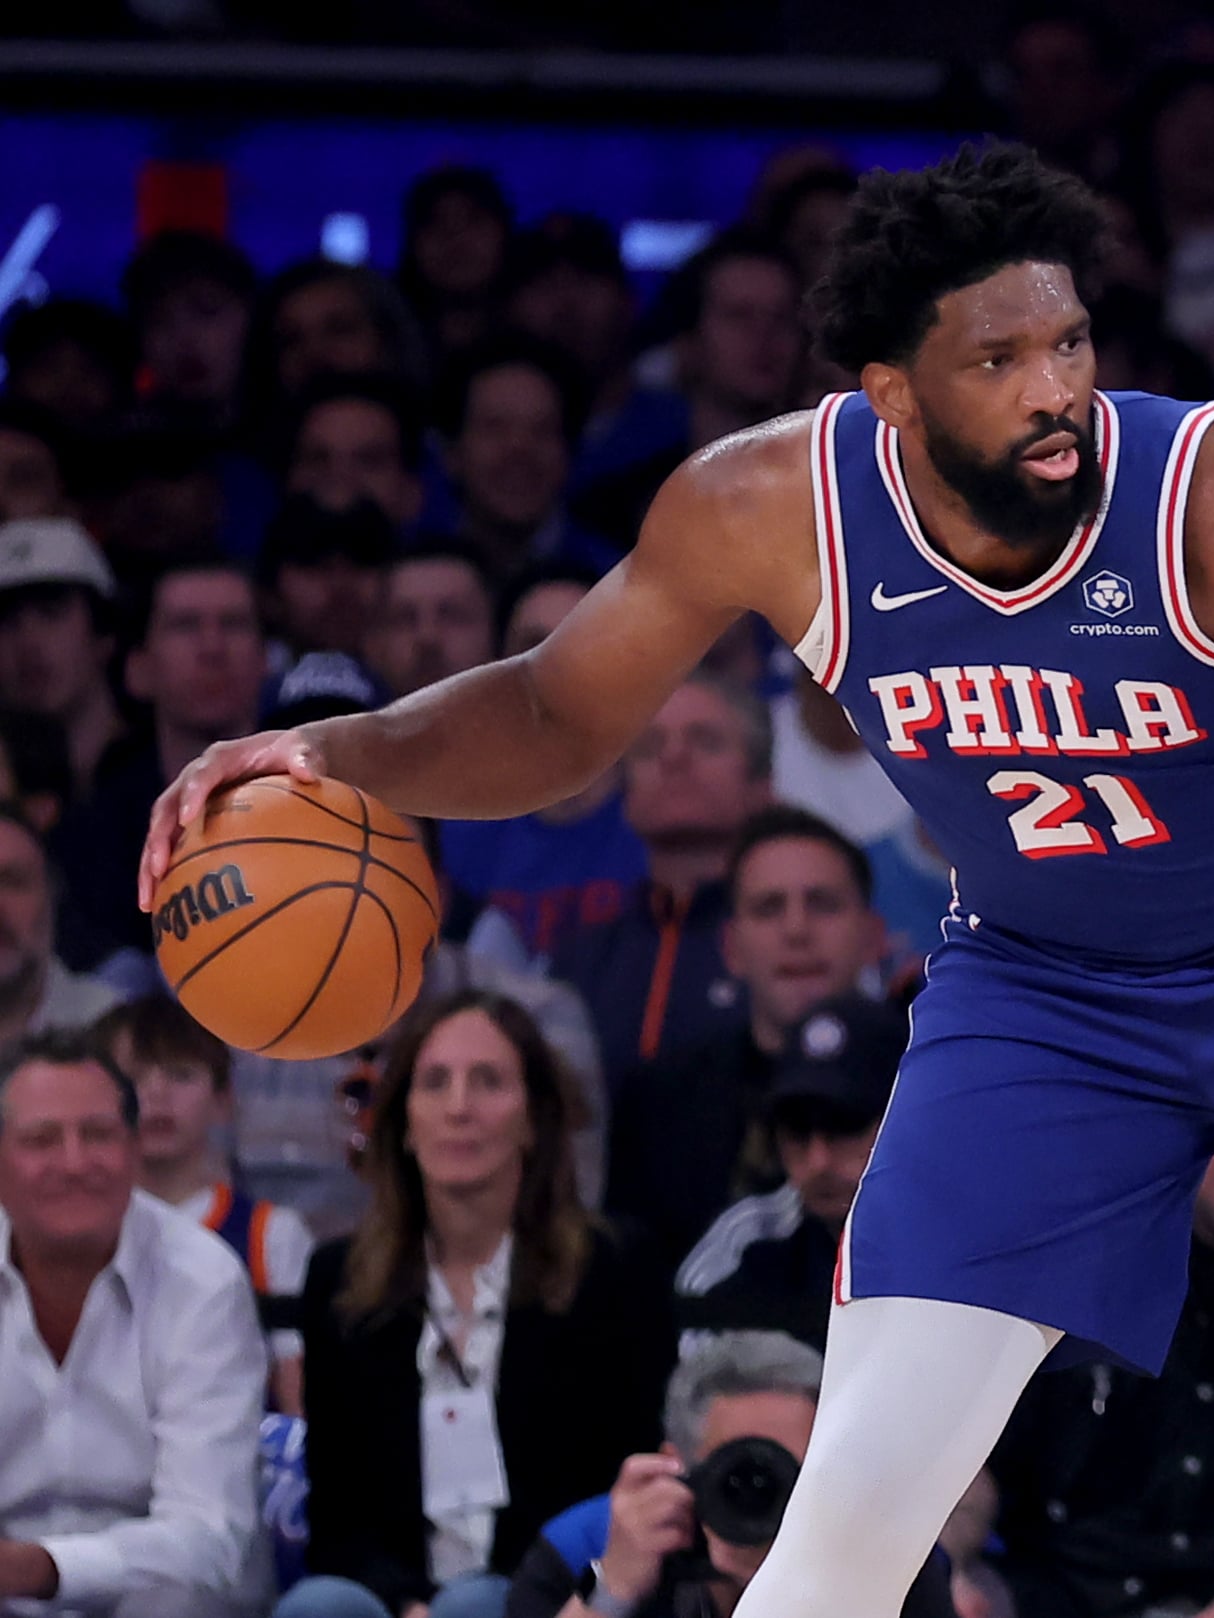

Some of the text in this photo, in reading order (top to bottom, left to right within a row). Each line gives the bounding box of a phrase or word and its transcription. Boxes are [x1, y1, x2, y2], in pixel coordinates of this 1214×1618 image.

[1069, 622, 1160, 637] crypto.com
[868, 664, 1208, 759] PHILA
[986, 770, 1172, 860] 21
